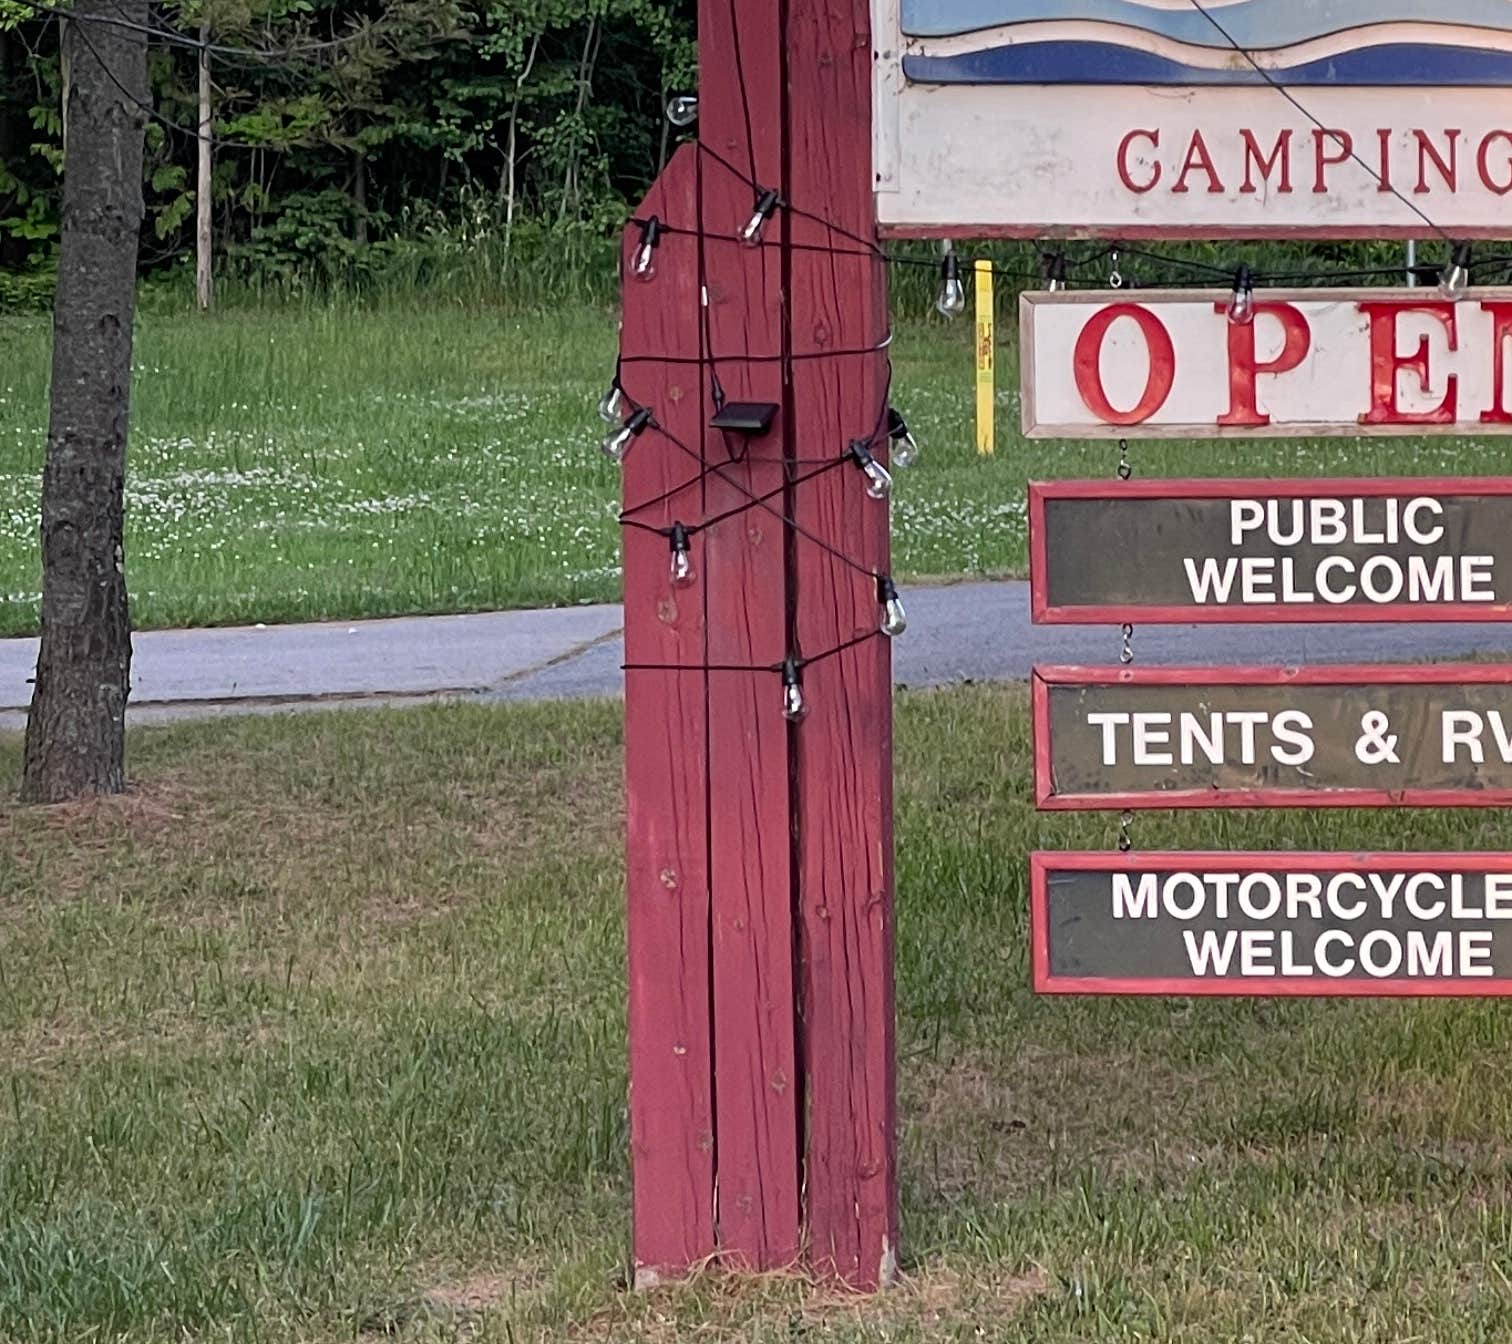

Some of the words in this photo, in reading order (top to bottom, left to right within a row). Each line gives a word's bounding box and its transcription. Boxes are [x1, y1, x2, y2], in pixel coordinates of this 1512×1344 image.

[1229, 497, 1444, 546] PUBLIC
[1184, 555, 1496, 603] WELCOME
[1087, 711, 1315, 766] TENTS
[1354, 711, 1400, 765] &
[1184, 930, 1495, 978] WELCOME
